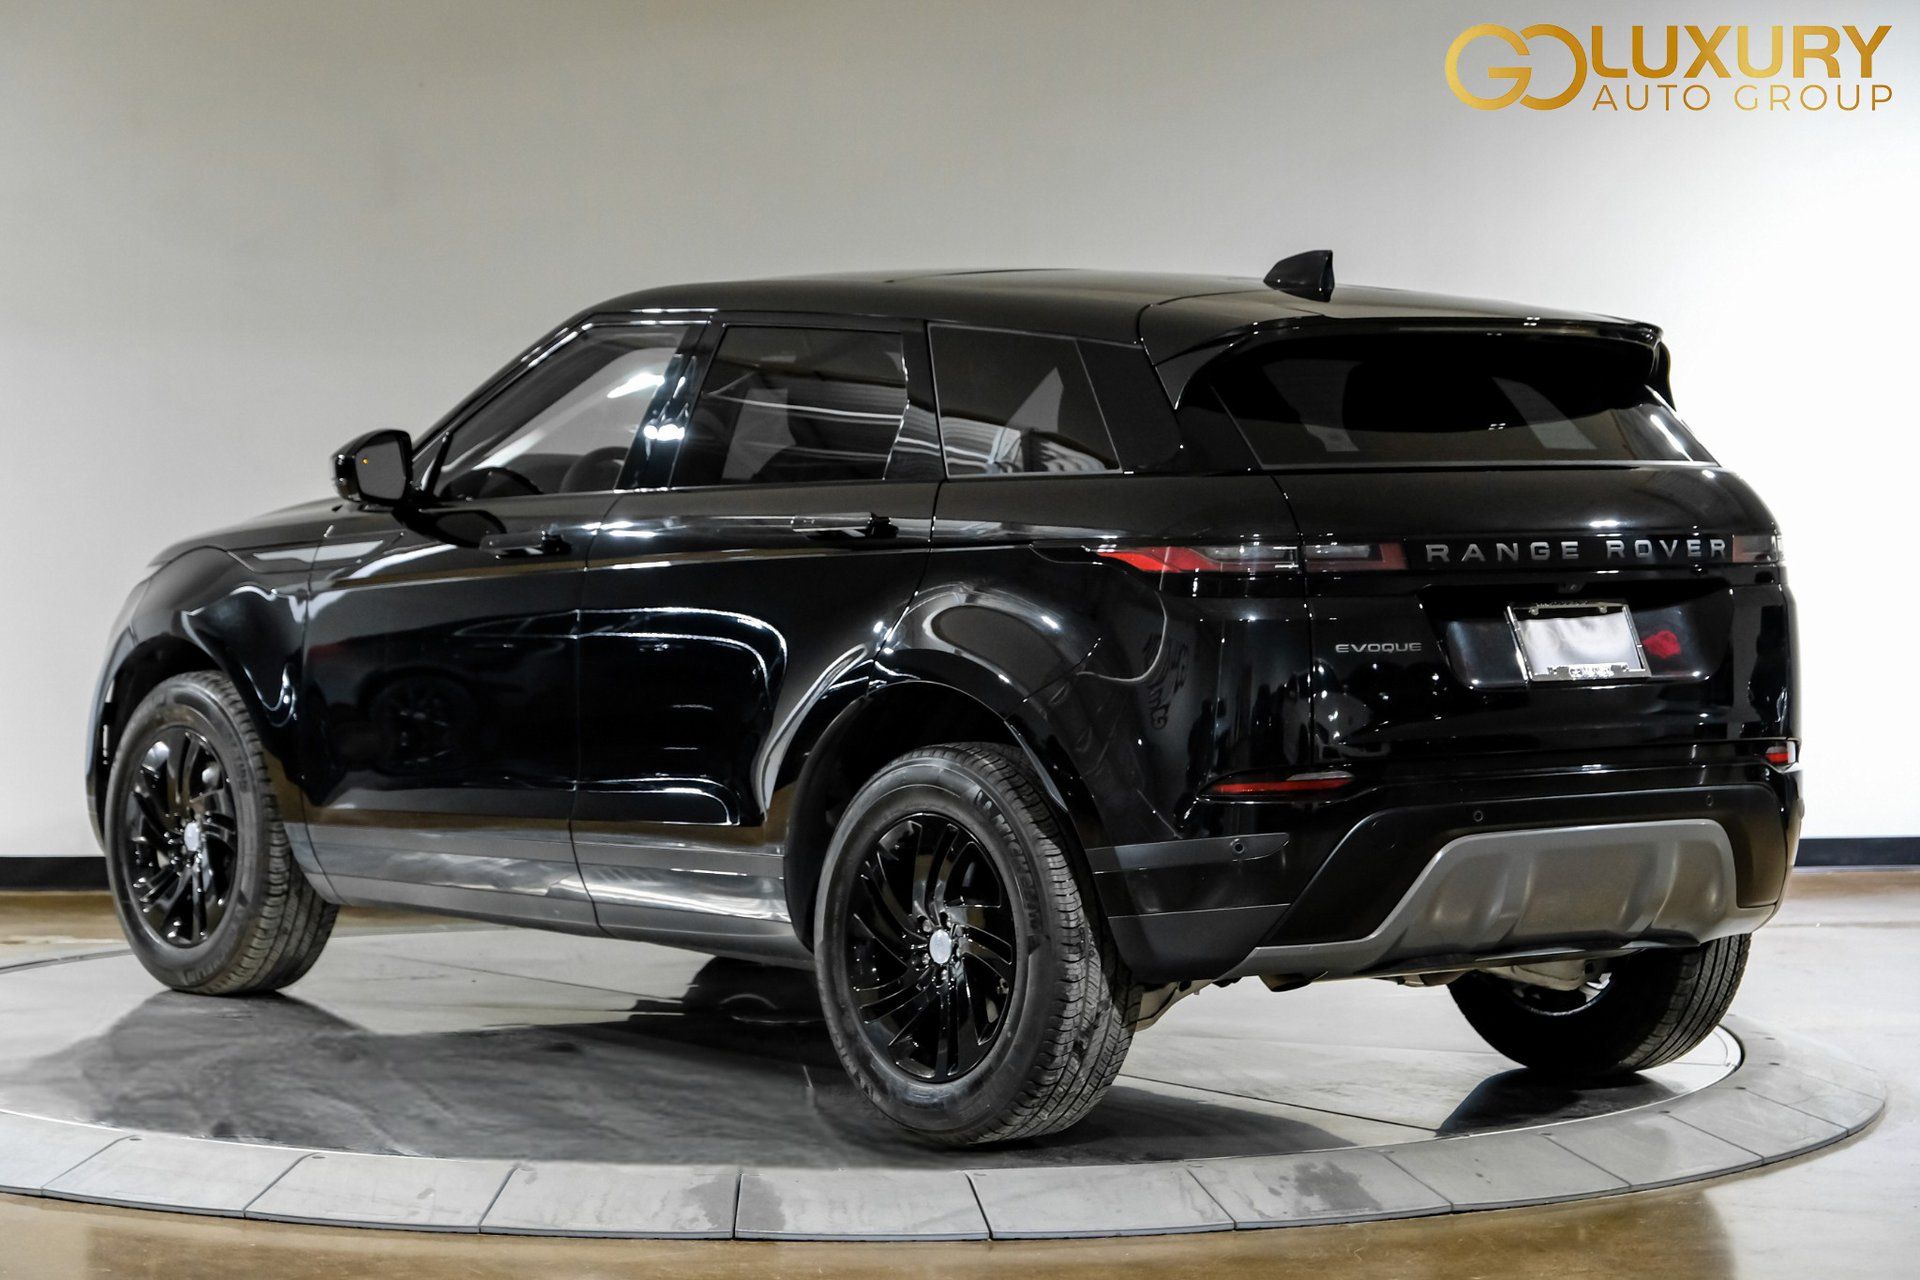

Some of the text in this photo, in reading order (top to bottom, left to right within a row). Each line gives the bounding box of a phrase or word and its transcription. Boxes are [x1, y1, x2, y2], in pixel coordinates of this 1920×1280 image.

[1425, 538, 1727, 563] RANGE ROVER
[1335, 642, 1422, 653] EVOQUE
